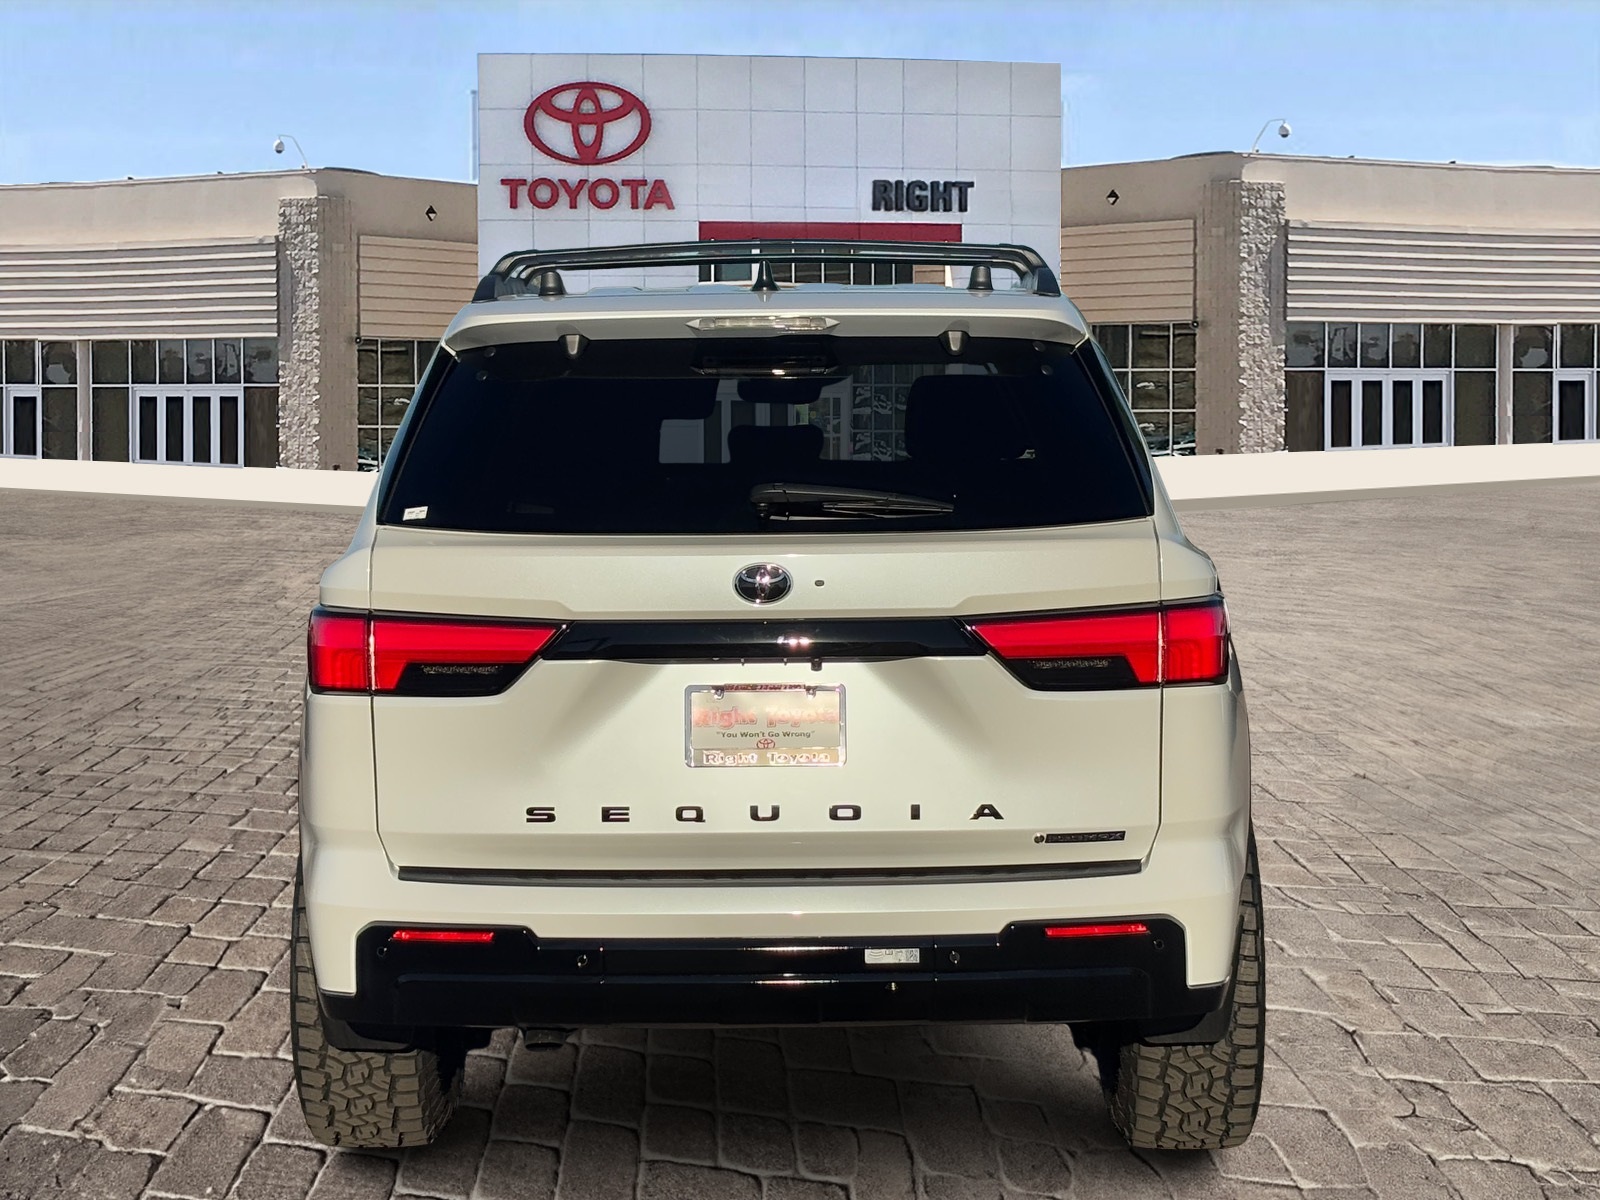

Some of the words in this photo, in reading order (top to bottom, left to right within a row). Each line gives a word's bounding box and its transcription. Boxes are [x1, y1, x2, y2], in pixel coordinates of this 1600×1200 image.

[500, 178, 675, 210] TOYOTA
[871, 180, 975, 212] RIGHT
[739, 730, 765, 738] Won't
[768, 730, 780, 738] Go
[703, 752, 758, 766] Right
[767, 752, 830, 766] Toyota
[526, 804, 1005, 823] SEQUOIA
